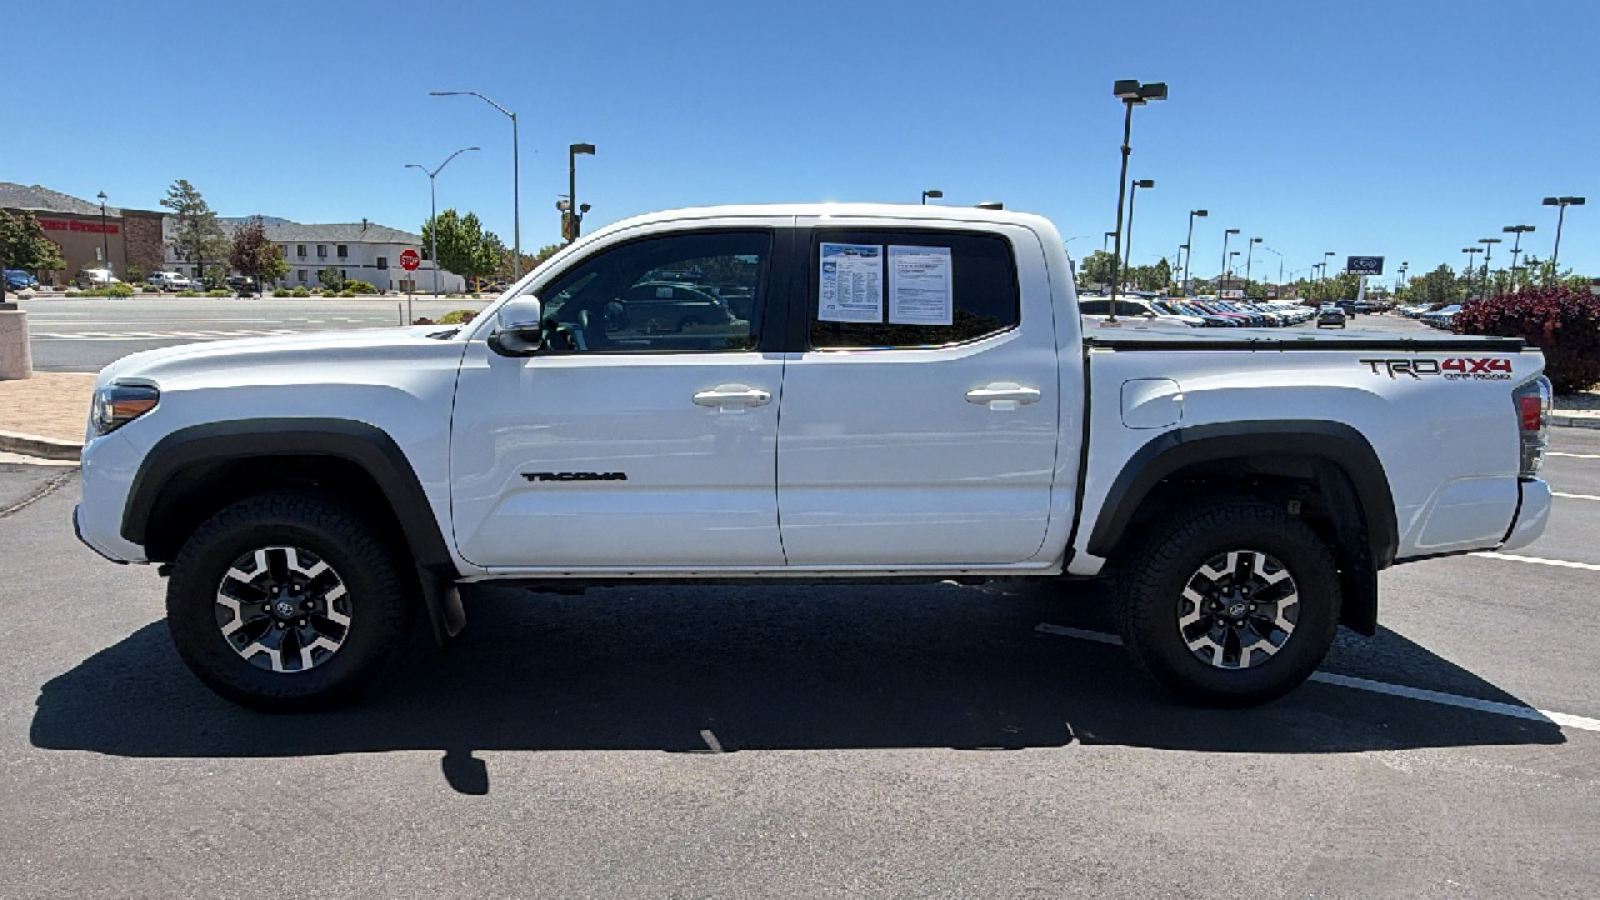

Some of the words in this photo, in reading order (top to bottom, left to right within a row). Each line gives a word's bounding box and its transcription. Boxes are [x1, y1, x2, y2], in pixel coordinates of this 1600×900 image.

[401, 255, 418, 266] STOP
[1359, 358, 1442, 381] TRD
[1443, 373, 1472, 381] OFF
[1474, 373, 1512, 381] ROAD
[520, 472, 628, 482] TACOMA
